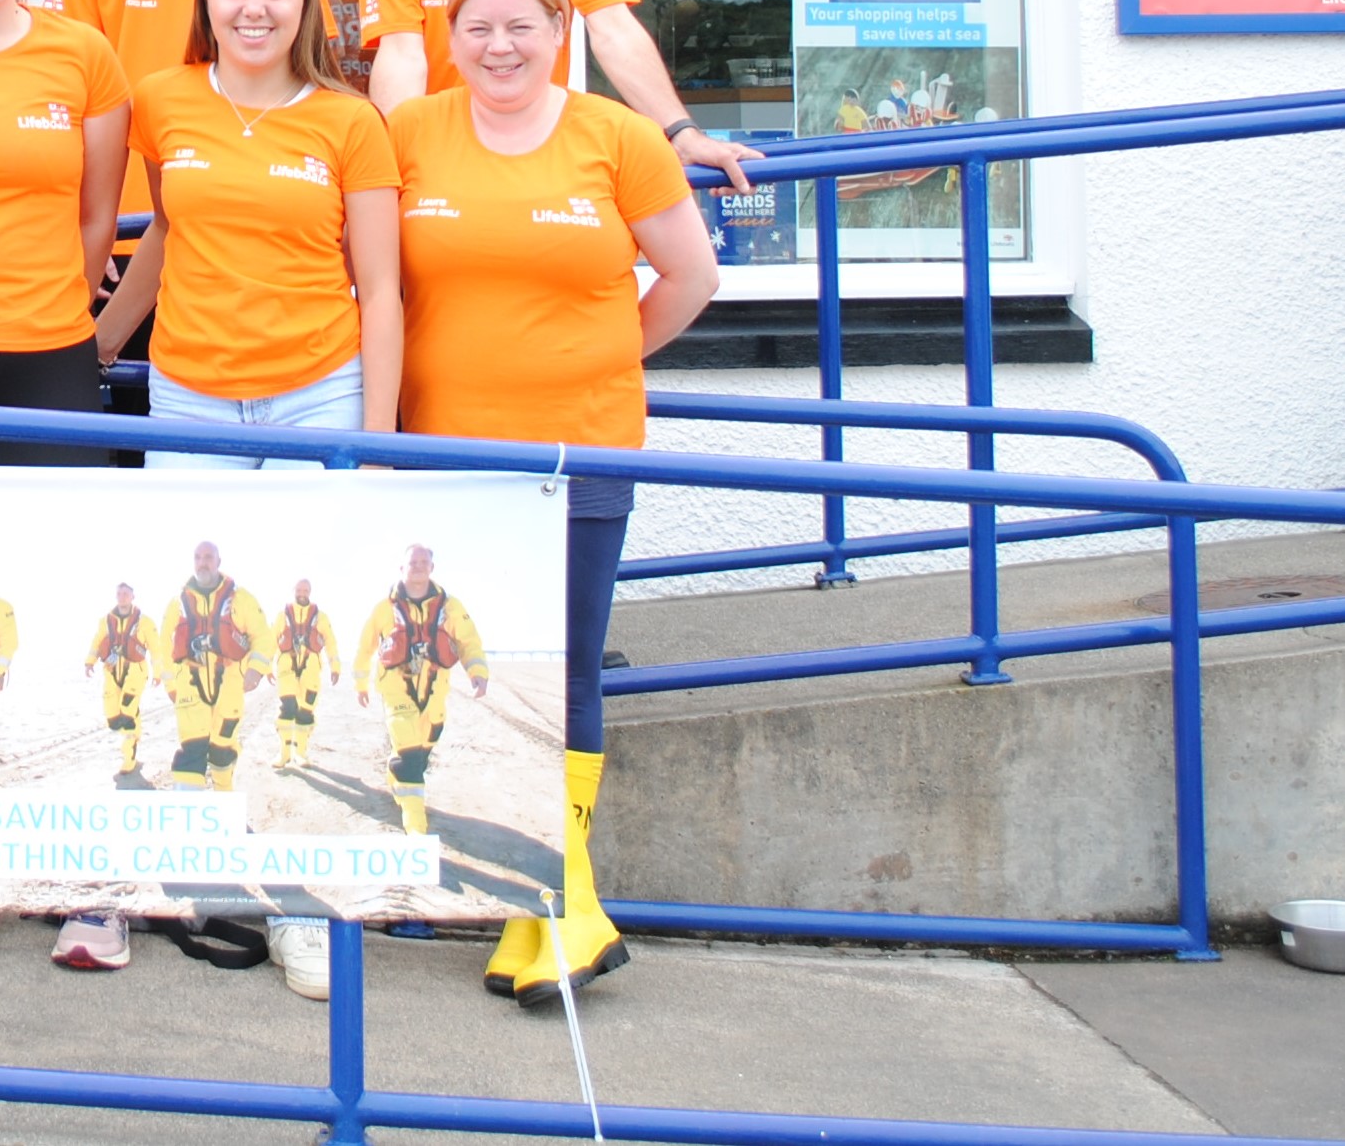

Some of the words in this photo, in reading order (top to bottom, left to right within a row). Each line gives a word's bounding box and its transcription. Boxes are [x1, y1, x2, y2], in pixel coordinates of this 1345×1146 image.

[809, 7, 843, 23] Your
[846, 7, 913, 25] shopping
[916, 6, 958, 24] helps
[862, 28, 896, 41] save
[899, 26, 934, 41] lives
[937, 27, 952, 41] at
[954, 28, 981, 41] sea
[269, 164, 329, 186] Lifeboats
[721, 195, 775, 208] CARDS
[532, 210, 601, 228] Lifeboats
[123, 804, 231, 838] GIFTS,
[132, 845, 248, 876] CARDS
[262, 848, 334, 877] AND
[346, 849, 430, 878] TOYS
